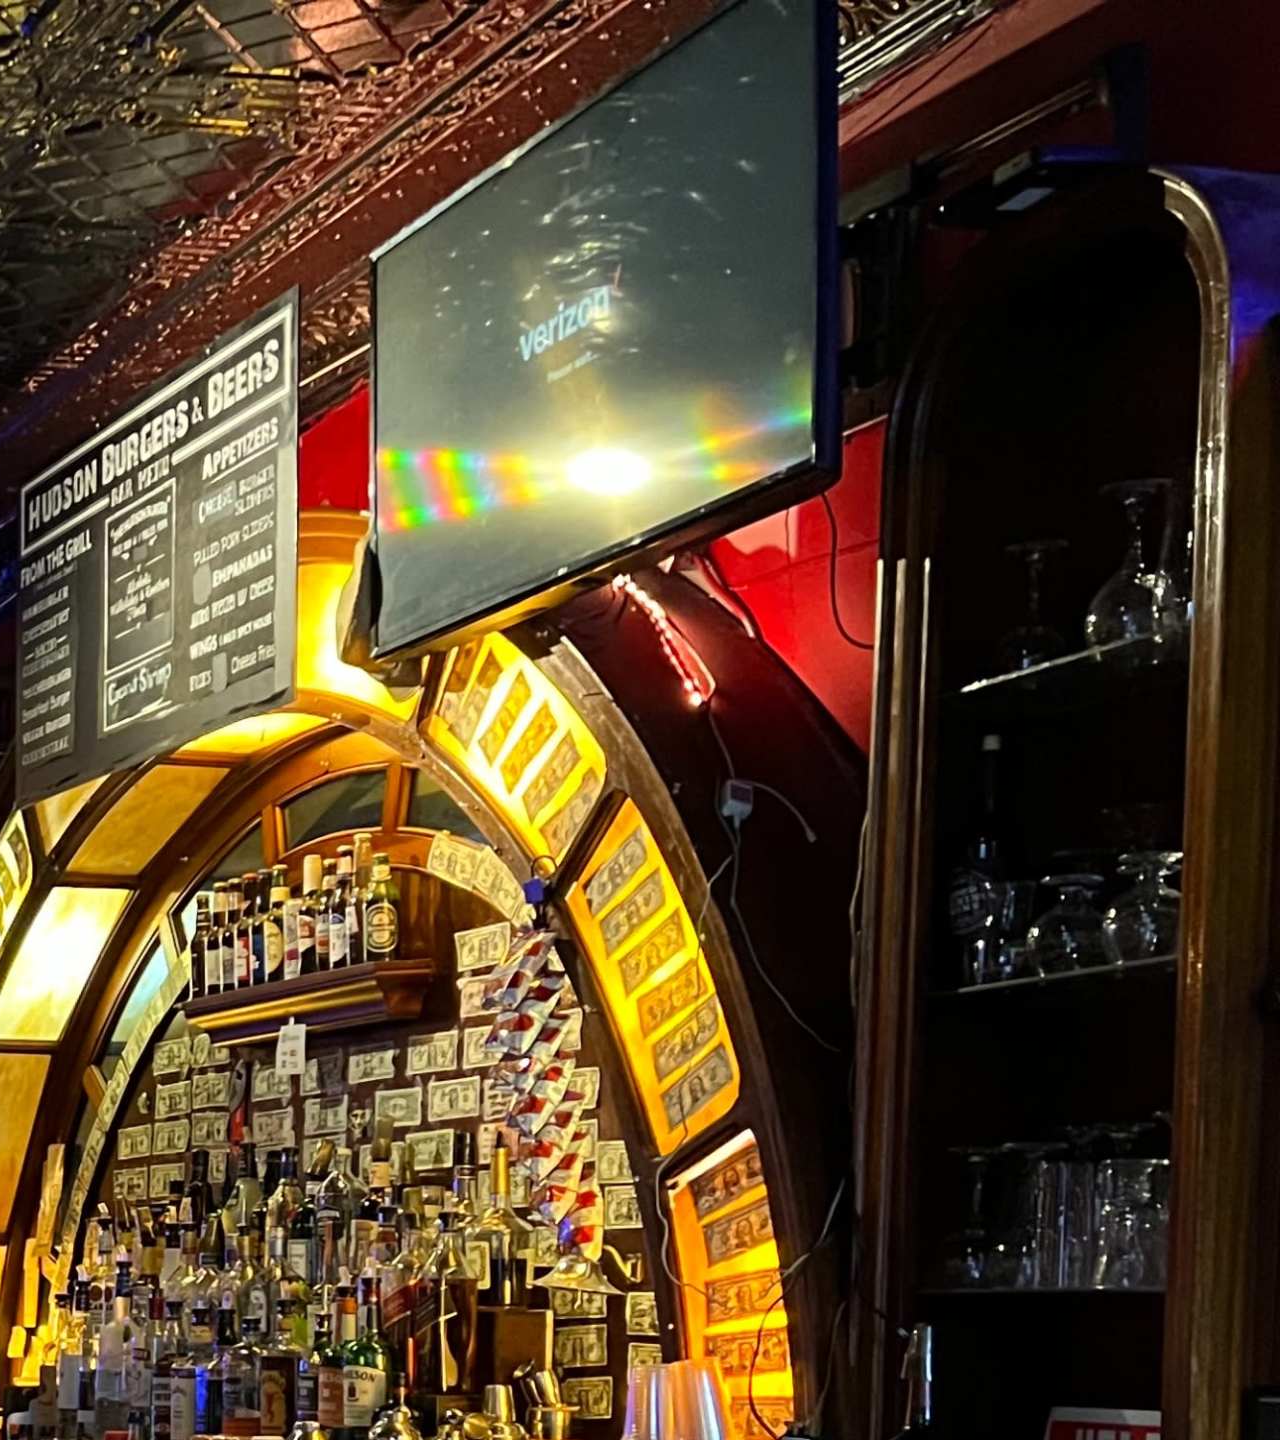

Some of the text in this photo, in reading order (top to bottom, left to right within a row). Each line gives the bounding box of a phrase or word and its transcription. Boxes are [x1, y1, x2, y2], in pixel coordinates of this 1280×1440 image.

[520, 286, 610, 361] verizon
[28, 459, 97, 532] HUDSON
[102, 400, 188, 485] BURGERS
[192, 396, 204, 424] &
[208, 339, 279, 419] BEERS
[202, 417, 278, 480] APPETIZERS
[110, 454, 170, 507] BAR MENU
[20, 555, 45, 588] FROM
[45, 544, 65, 573] THE
[65, 529, 92, 560] GRILL
[212, 544, 273, 588] EMPANADAS
